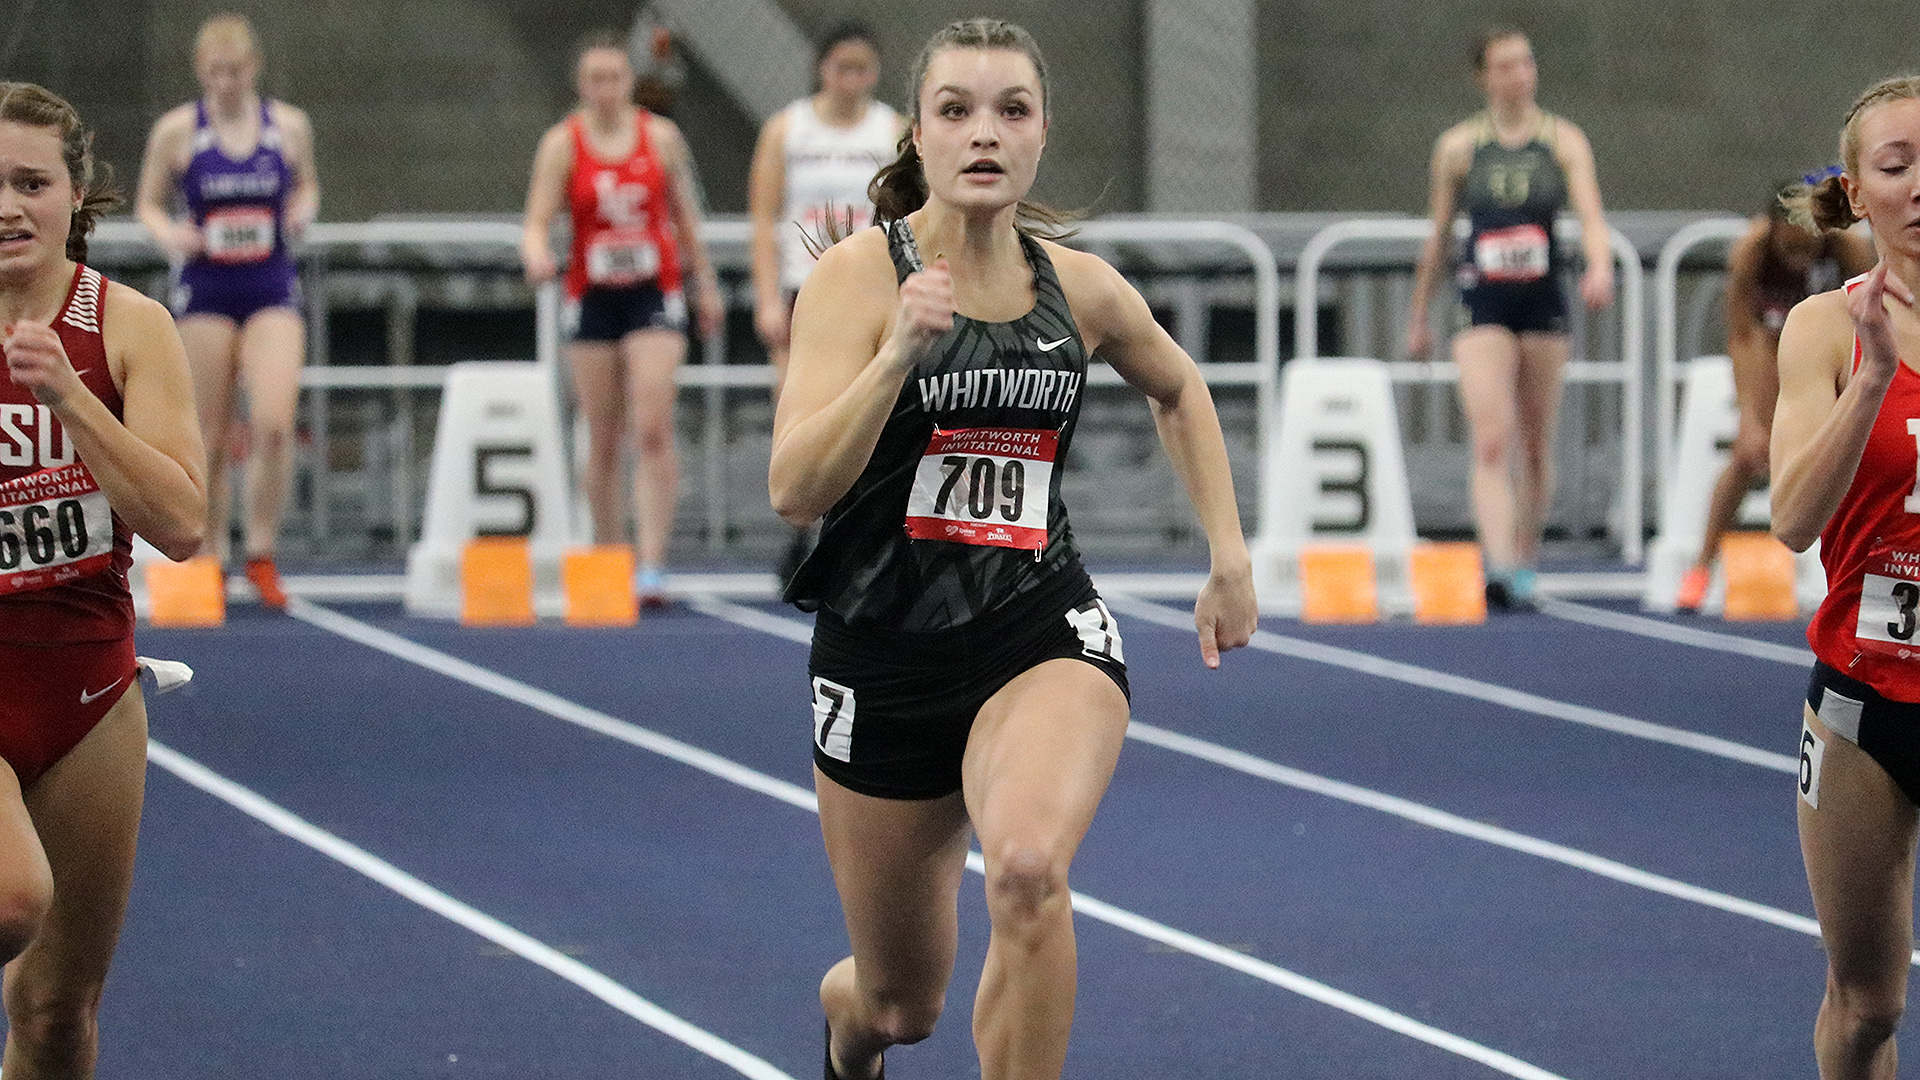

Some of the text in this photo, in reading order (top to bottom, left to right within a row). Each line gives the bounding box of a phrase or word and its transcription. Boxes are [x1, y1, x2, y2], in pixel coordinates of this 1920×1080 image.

[918, 369, 1081, 413] WHITWORTH
[941, 441, 1040, 456] INVITATIONAL
[952, 430, 1041, 443] WHITWORTH
[475, 445, 536, 537] 5
[934, 455, 1025, 522] 709
[1312, 439, 1369, 534] 3
[0, 499, 88, 570] 660
[1076, 599, 1112, 656] 7
[1887, 582, 1920, 640] 3
[819, 683, 844, 749] 7
[1800, 730, 1815, 795] 6
